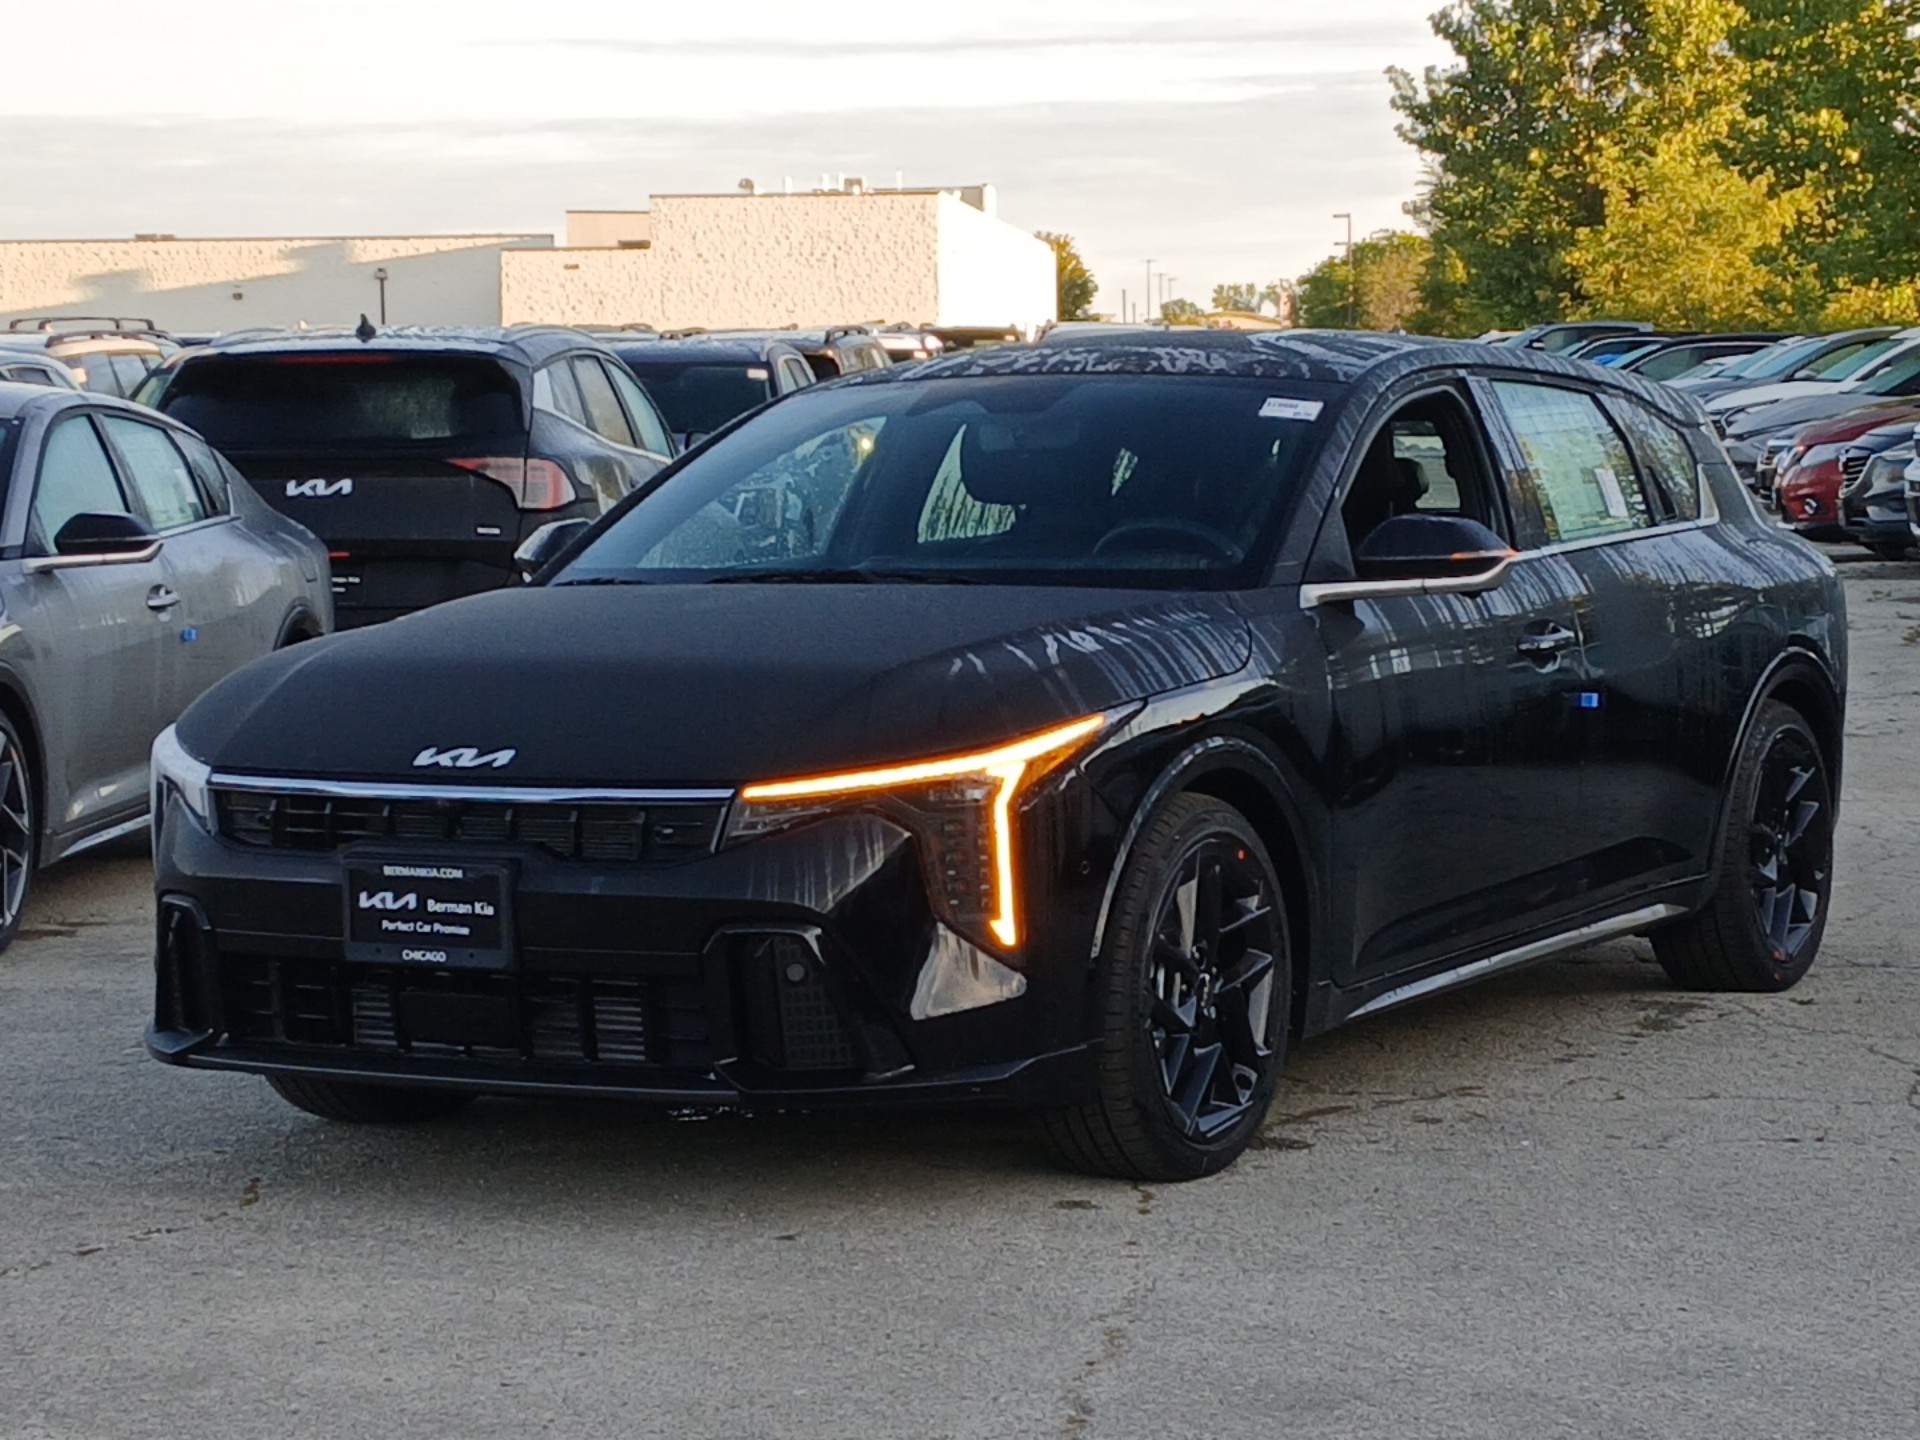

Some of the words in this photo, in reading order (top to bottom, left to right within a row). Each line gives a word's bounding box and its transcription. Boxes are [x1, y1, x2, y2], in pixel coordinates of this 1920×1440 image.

[286, 478, 352, 497] KIA
[412, 747, 516, 768] KIA
[359, 890, 417, 910] KIA
[427, 899, 472, 914] Berman
[474, 901, 494, 916] Kia
[382, 919, 414, 932] Perfect
[416, 921, 431, 933] Car
[402, 949, 446, 962] CHICAGO
